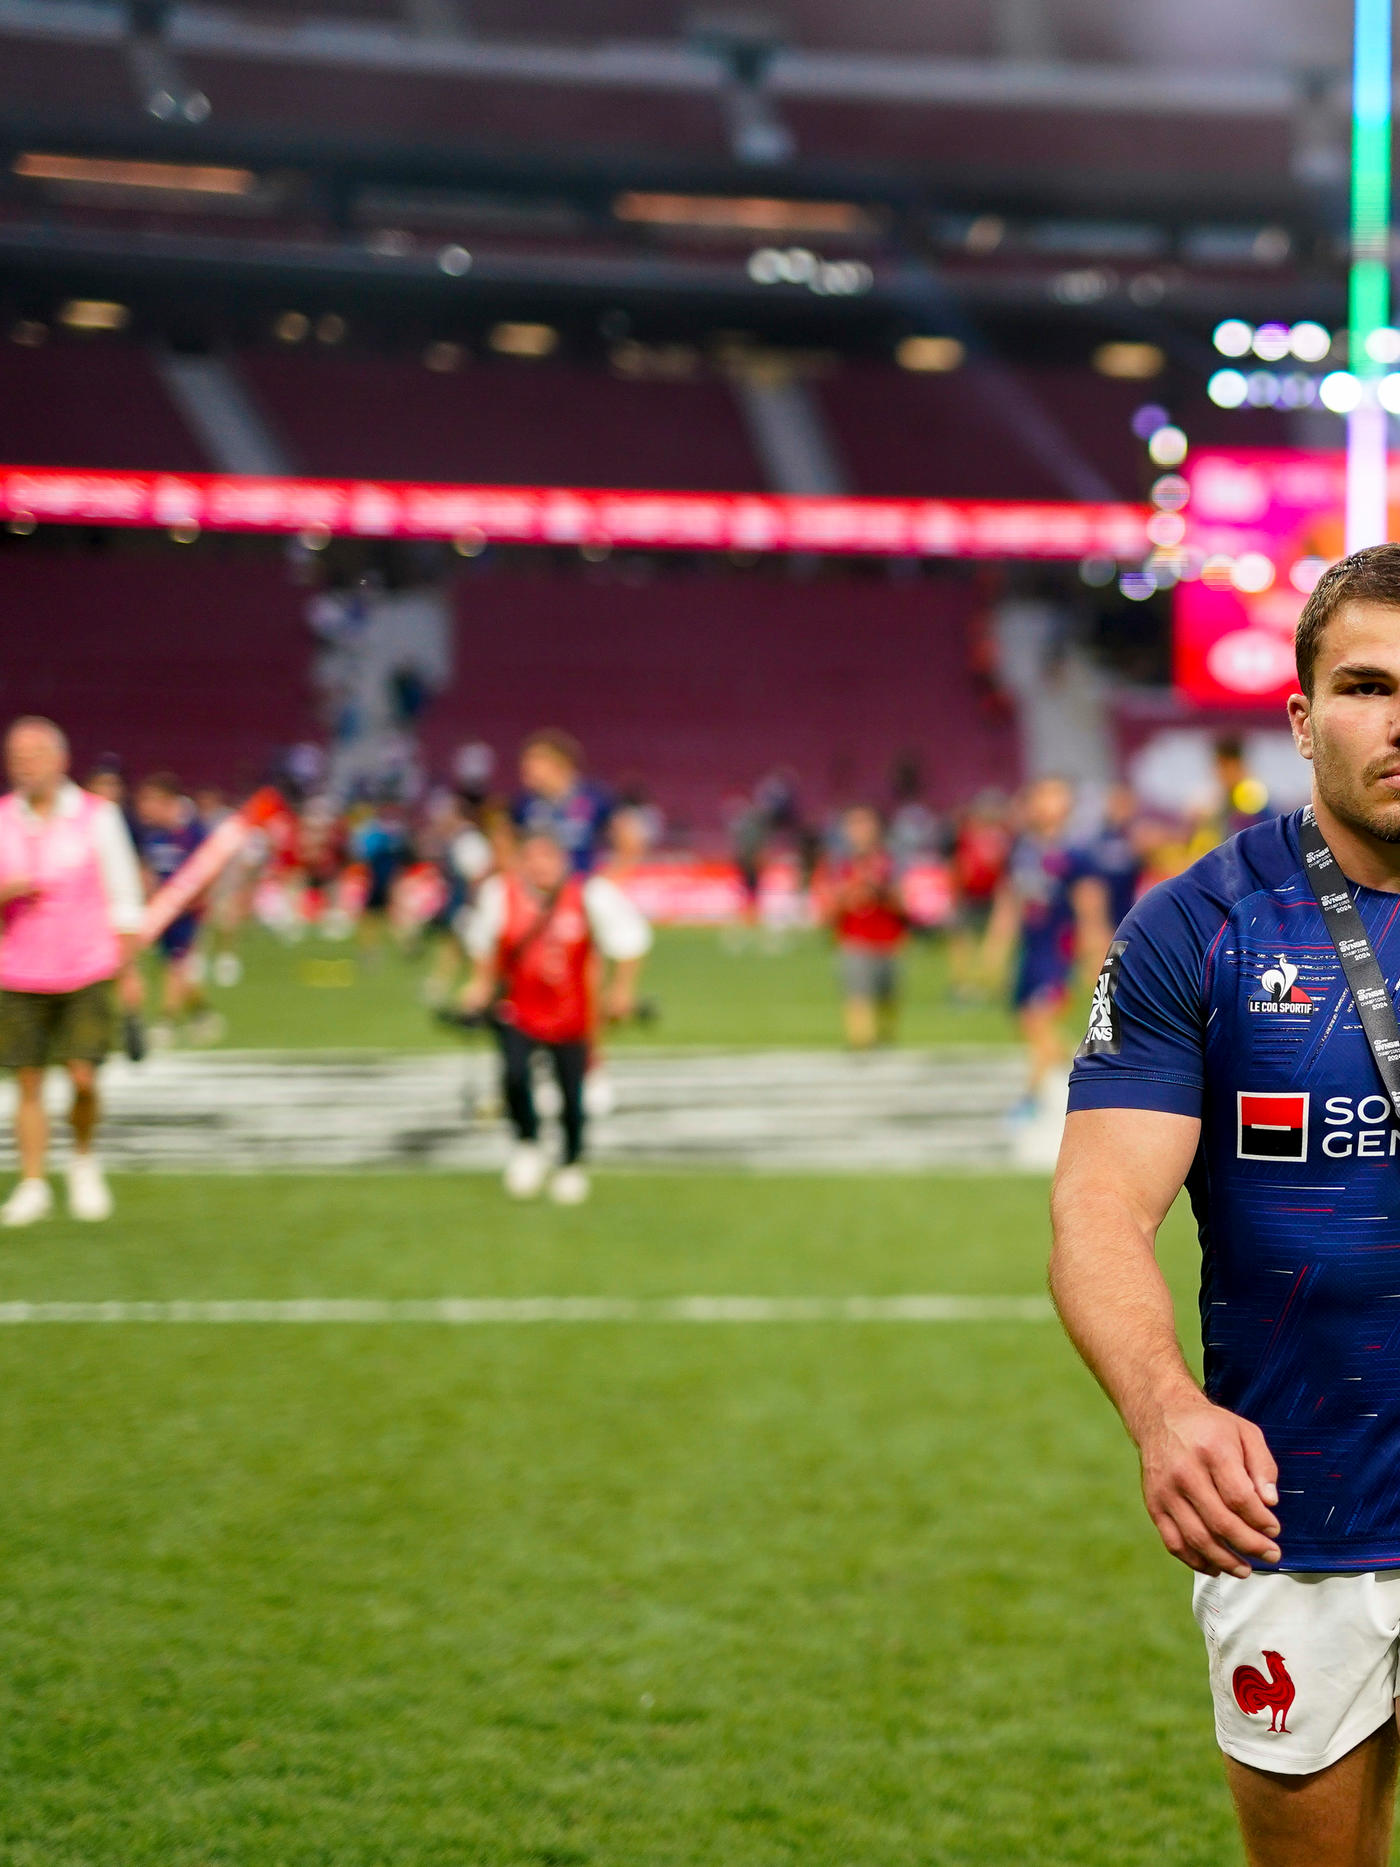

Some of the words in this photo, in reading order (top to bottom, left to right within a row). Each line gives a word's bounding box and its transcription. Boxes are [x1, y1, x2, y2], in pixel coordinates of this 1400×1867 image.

[1336, 905, 1352, 913] 2024
[1354, 952, 1370, 961] 2024
[1250, 1001, 1260, 1012] LE
[1261, 1002, 1278, 1012] COQ
[1279, 1002, 1312, 1013] SPORTIF
[1372, 1002, 1388, 1010] 2024
